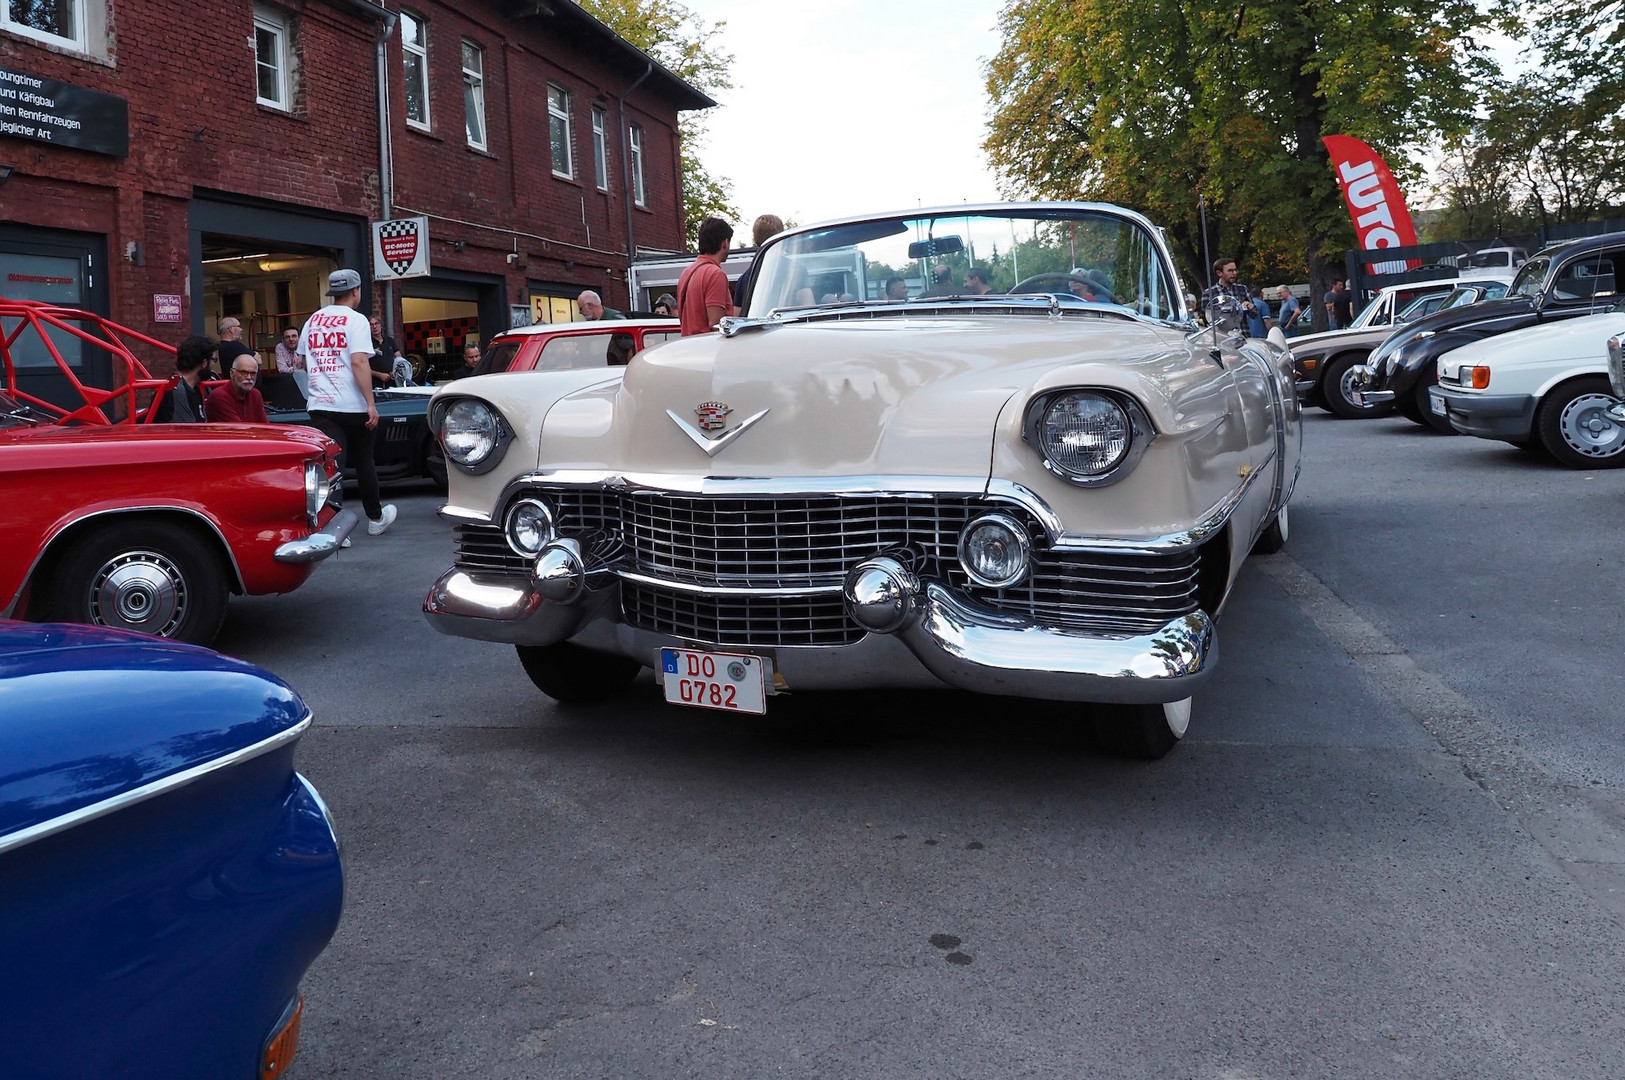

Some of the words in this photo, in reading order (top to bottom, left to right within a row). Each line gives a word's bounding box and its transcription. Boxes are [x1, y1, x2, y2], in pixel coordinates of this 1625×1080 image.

[0, 87, 16, 100] und
[19, 91, 55, 108] Käfigbau
[18, 107, 81, 130] Rennfahrzeugen
[0, 120, 35, 136] jeglicher
[37, 128, 52, 140] Art
[386, 248, 414, 256] Service
[308, 313, 348, 329] Pizza
[308, 332, 348, 350] SLICE
[316, 357, 337, 365] SLICE
[667, 664, 675, 672] D
[686, 653, 716, 678] DO
[679, 679, 738, 708] 0782
